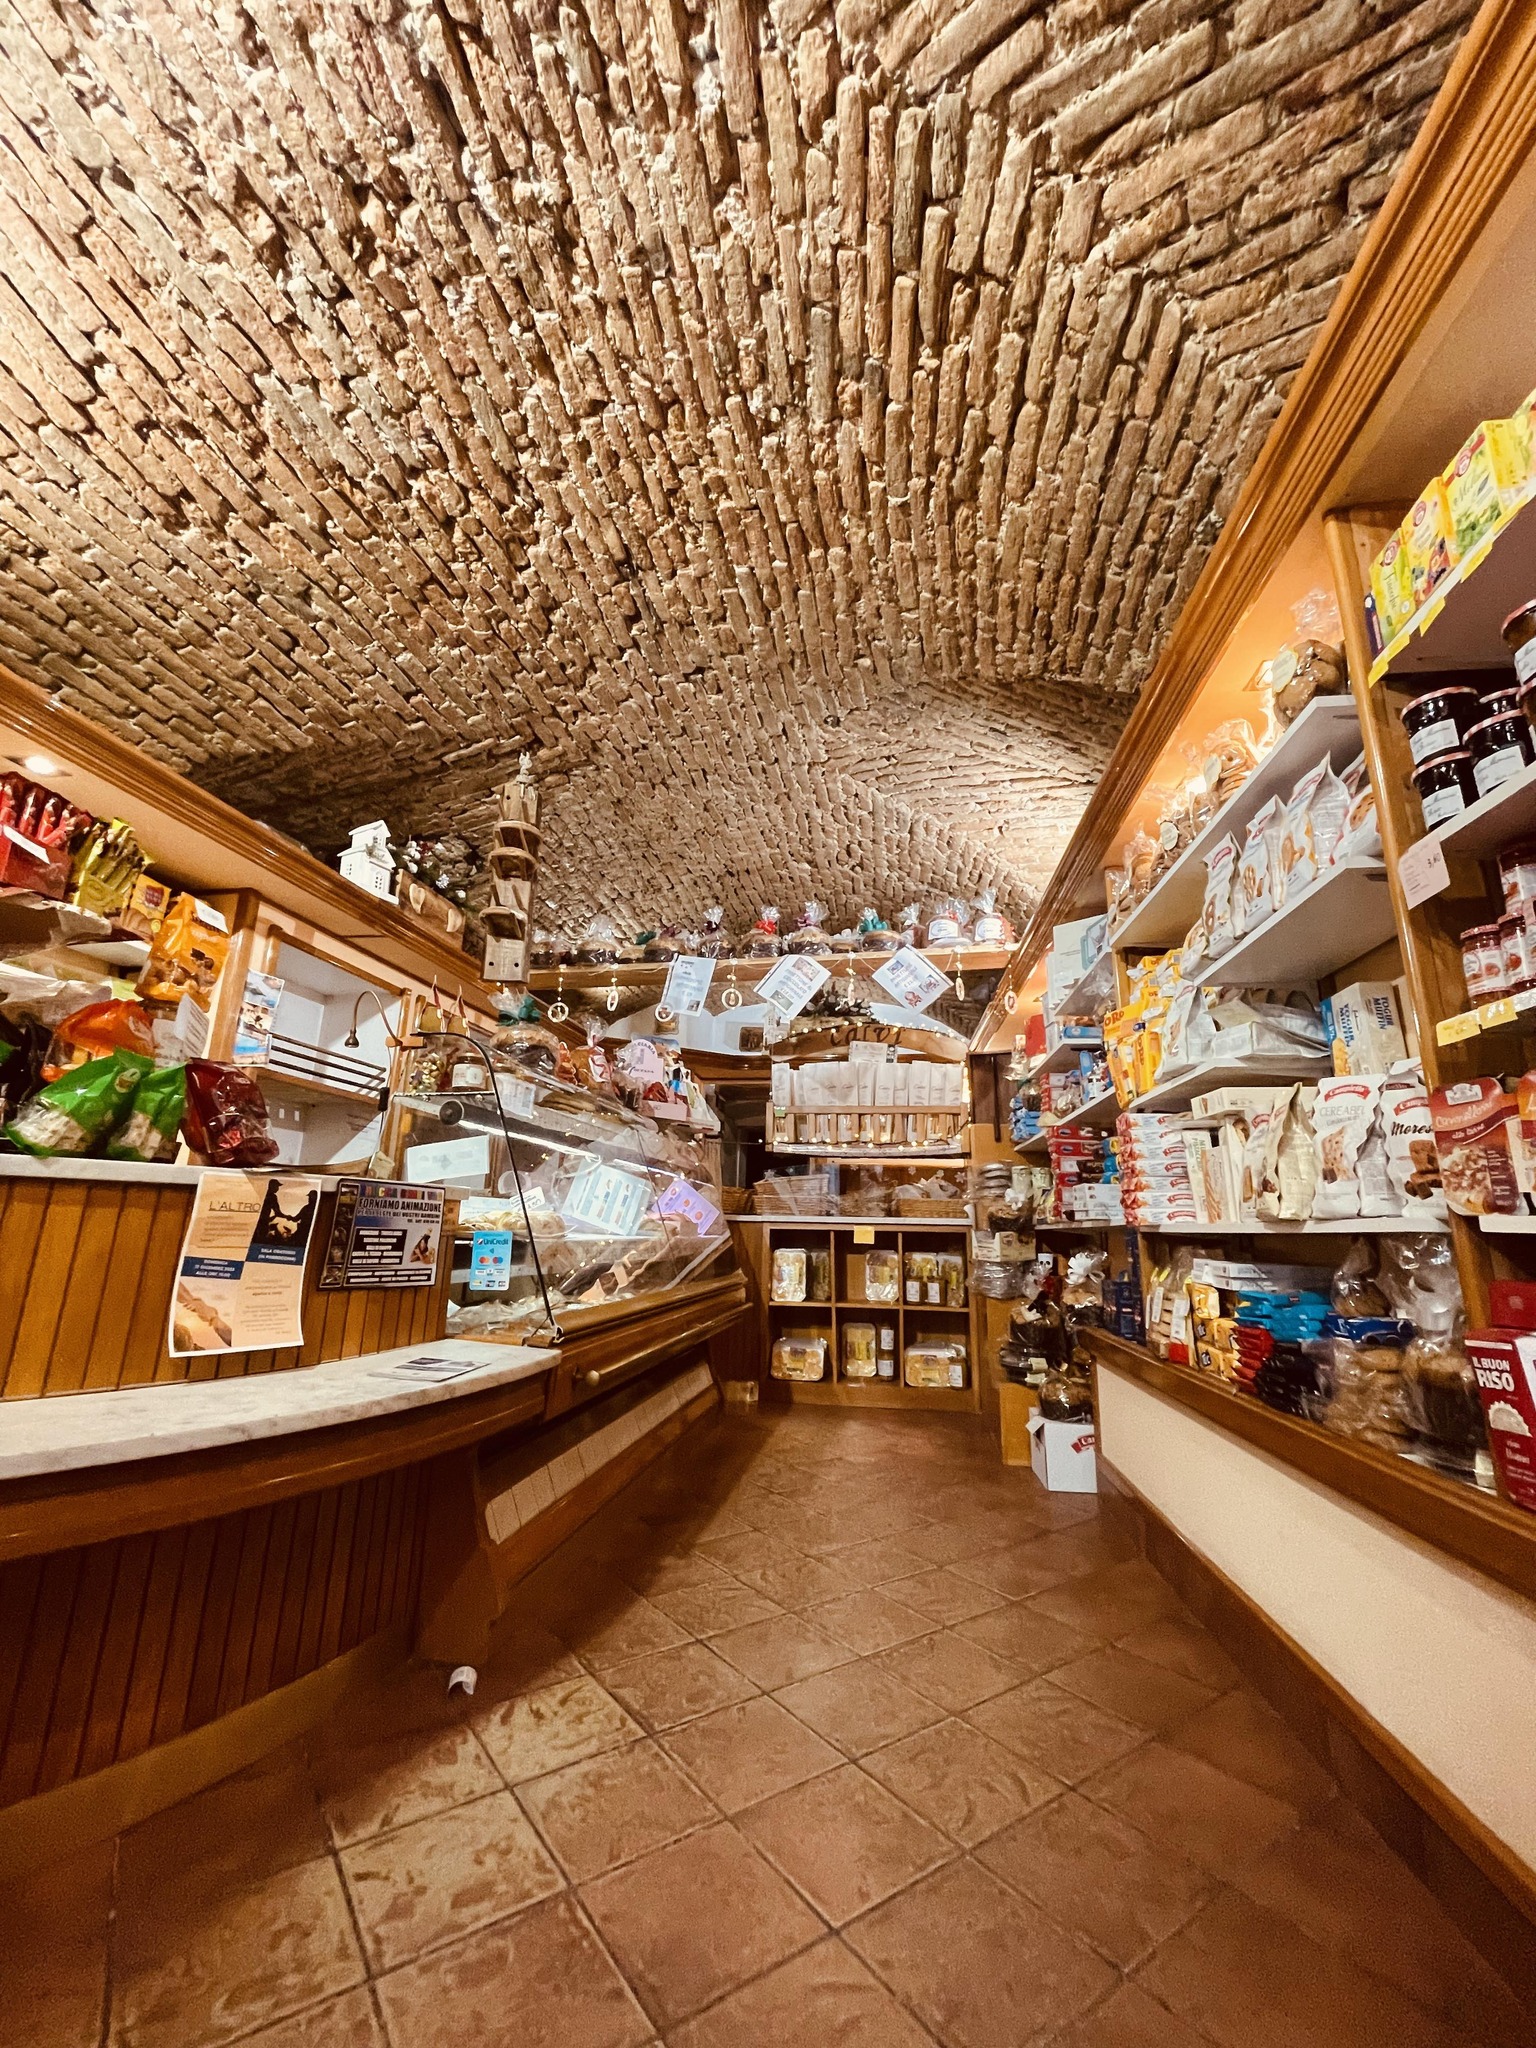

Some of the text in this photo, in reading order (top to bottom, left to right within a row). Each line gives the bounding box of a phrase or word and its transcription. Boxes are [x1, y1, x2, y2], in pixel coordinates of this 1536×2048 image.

[209, 1201, 261, 1212] L'ALTRO
[359, 1198, 441, 1212] FORNIAMO ANIMAZIONE
[483, 1237, 509, 1245] UniCredit
[1481, 1358, 1510, 1371] BUON
[1475, 1368, 1515, 1392] RISO
